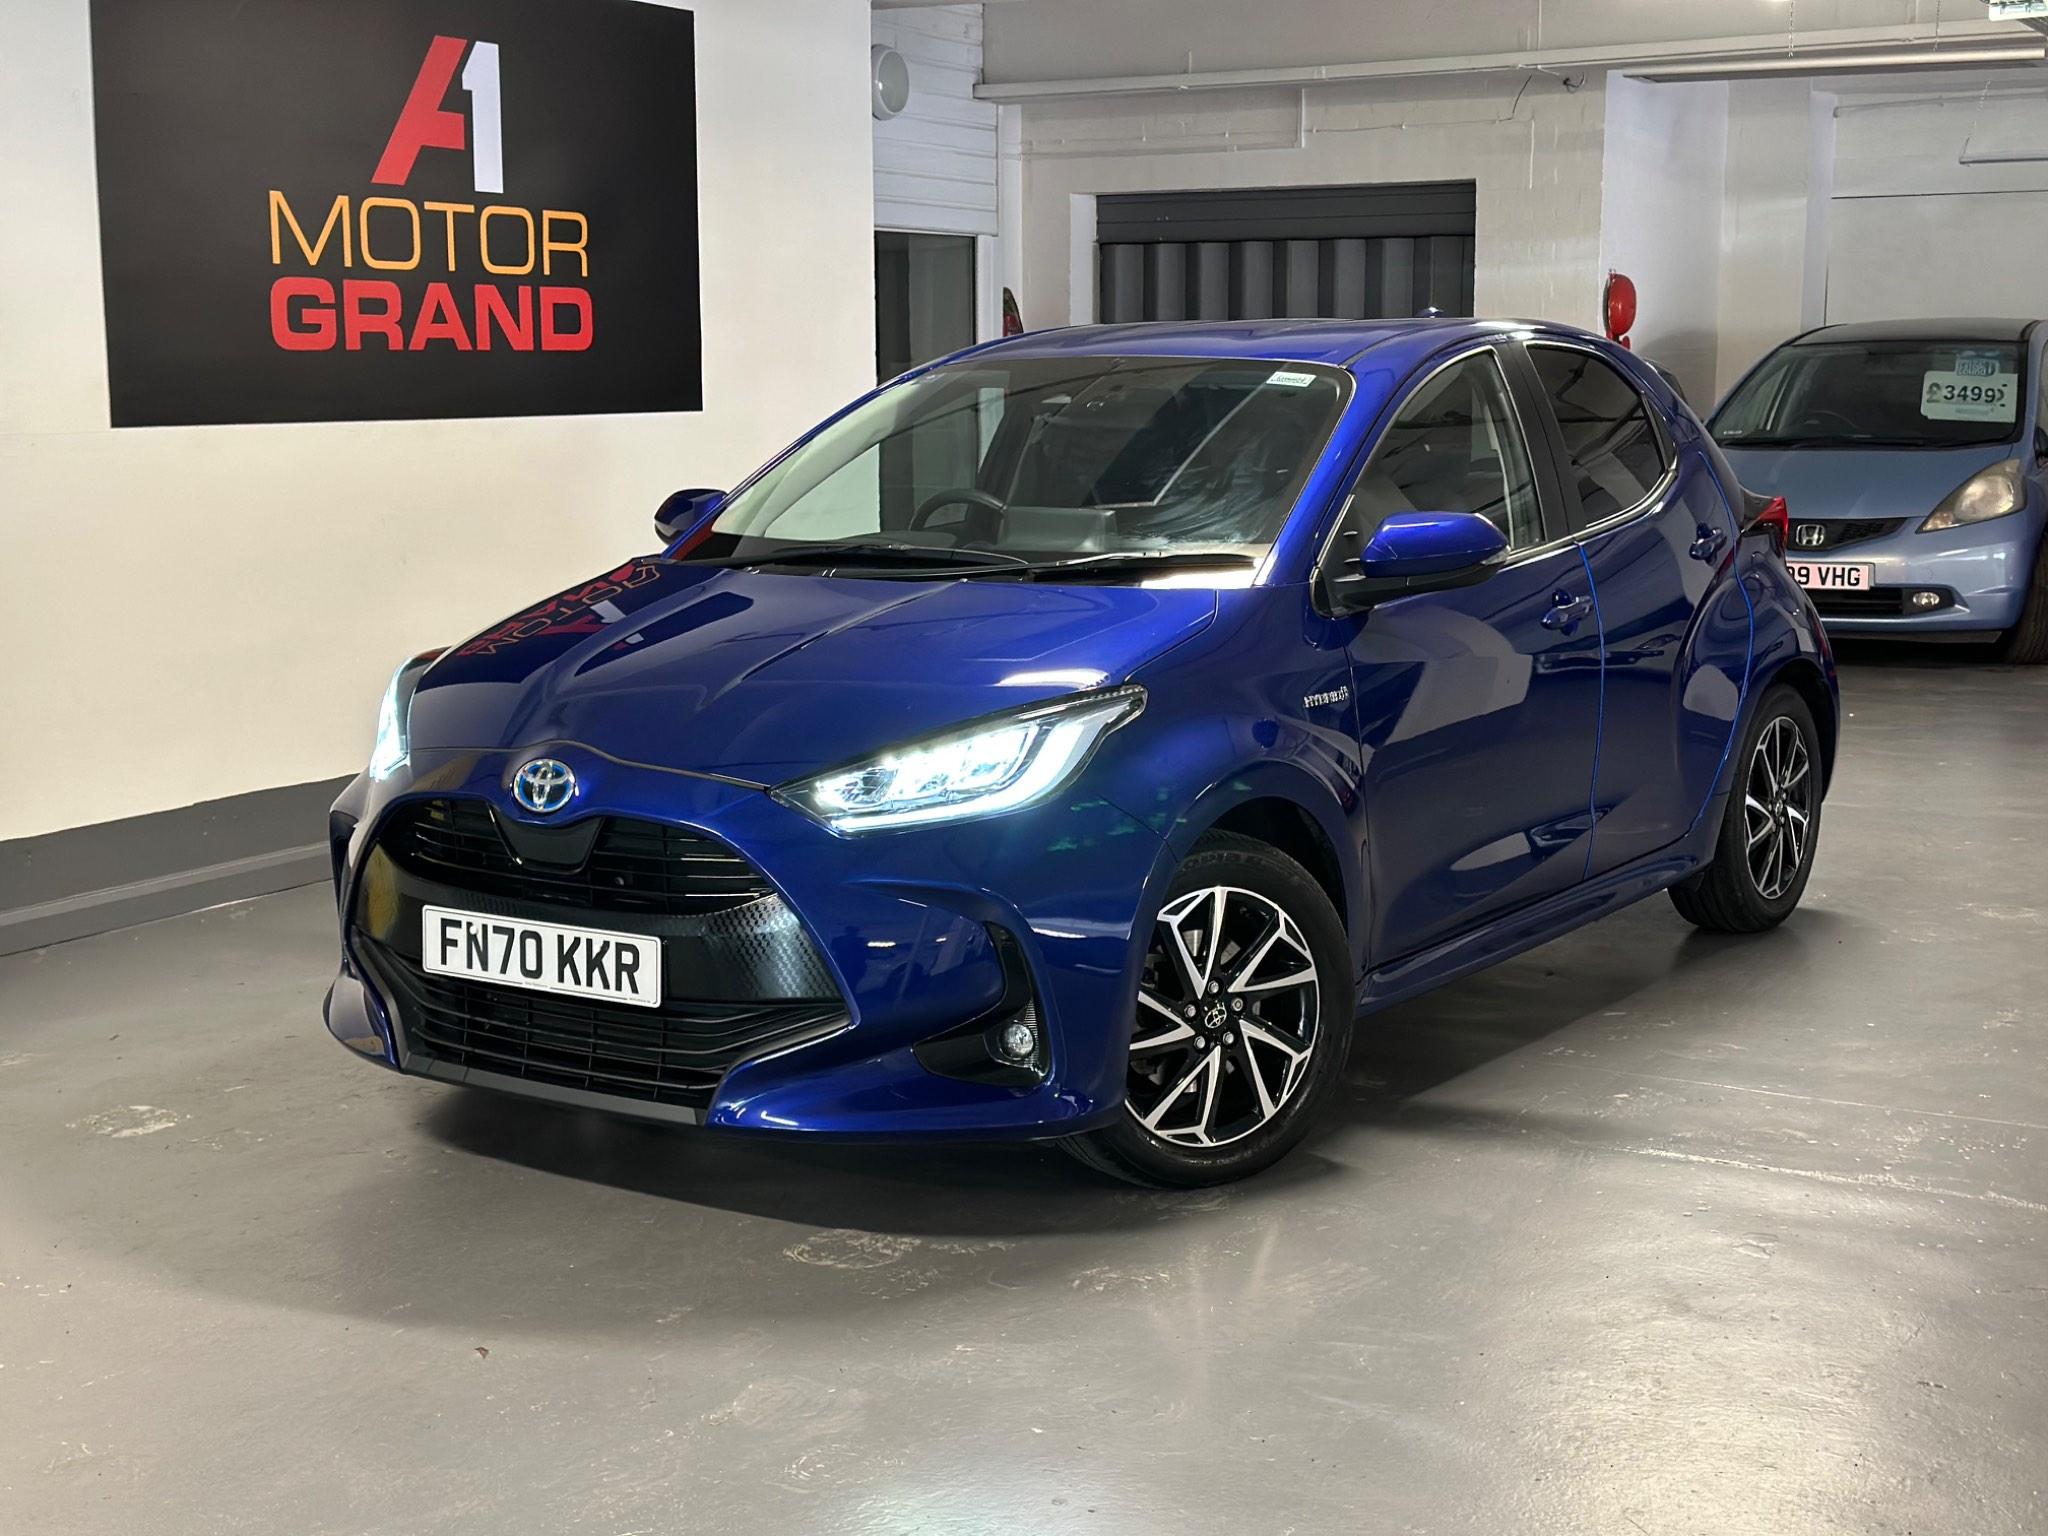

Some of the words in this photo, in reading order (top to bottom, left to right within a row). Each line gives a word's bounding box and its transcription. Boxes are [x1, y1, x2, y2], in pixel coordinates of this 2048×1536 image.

[371, 35, 503, 193] A1
[269, 190, 588, 277] MOTOR
[270, 277, 593, 351] GRAND
[1818, 566, 1861, 586] VHG
[440, 917, 543, 980] FN70
[557, 933, 640, 995] KKR
